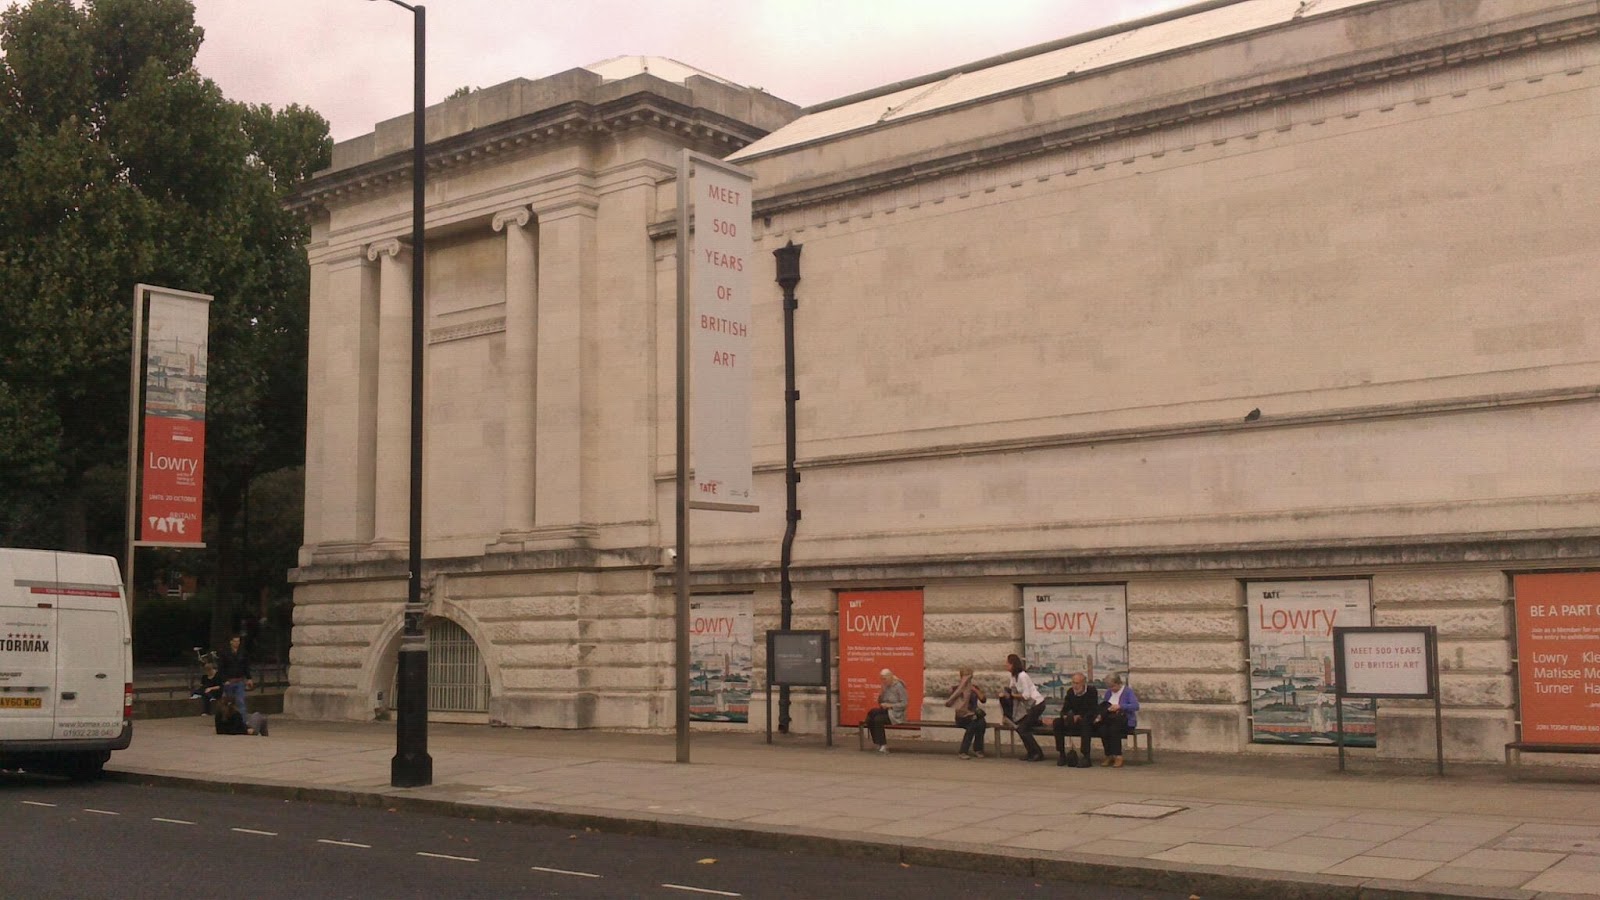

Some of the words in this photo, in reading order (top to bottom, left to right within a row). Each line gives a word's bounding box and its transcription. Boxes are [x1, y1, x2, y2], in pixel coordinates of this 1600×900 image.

[708, 184, 741, 206] MEET
[713, 218, 737, 238] 500
[704, 248, 743, 272] YEARS
[717, 285, 732, 301] OF
[701, 314, 747, 338] BRITISH
[713, 350, 736, 368] ART
[150, 451, 198, 476] Lowry
[700, 482, 717, 494] TATE
[169, 511, 197, 520] BRITAIN
[148, 516, 185, 534] TATE
[1530, 605, 1545, 617] BE
[1548, 604, 1558, 617] A
[1561, 604, 1592, 617] PART
[846, 610, 900, 638] Lowry
[1034, 607, 1098, 637] Lowry
[1260, 604, 1337, 637] Lowry
[0, 639, 49, 652] TORMAX
[1350, 647, 1373, 655] MEET
[1375, 646, 1392, 655] 500
[1394, 646, 1422, 655] YEARS
[1353, 661, 1366, 669] OF
[1367, 660, 1400, 669] BRITISH
[1402, 660, 1420, 669] ART
[1532, 651, 1568, 665] Lowry
[1534, 667, 1581, 679] Matisse
[1534, 681, 1574, 694] Turner
